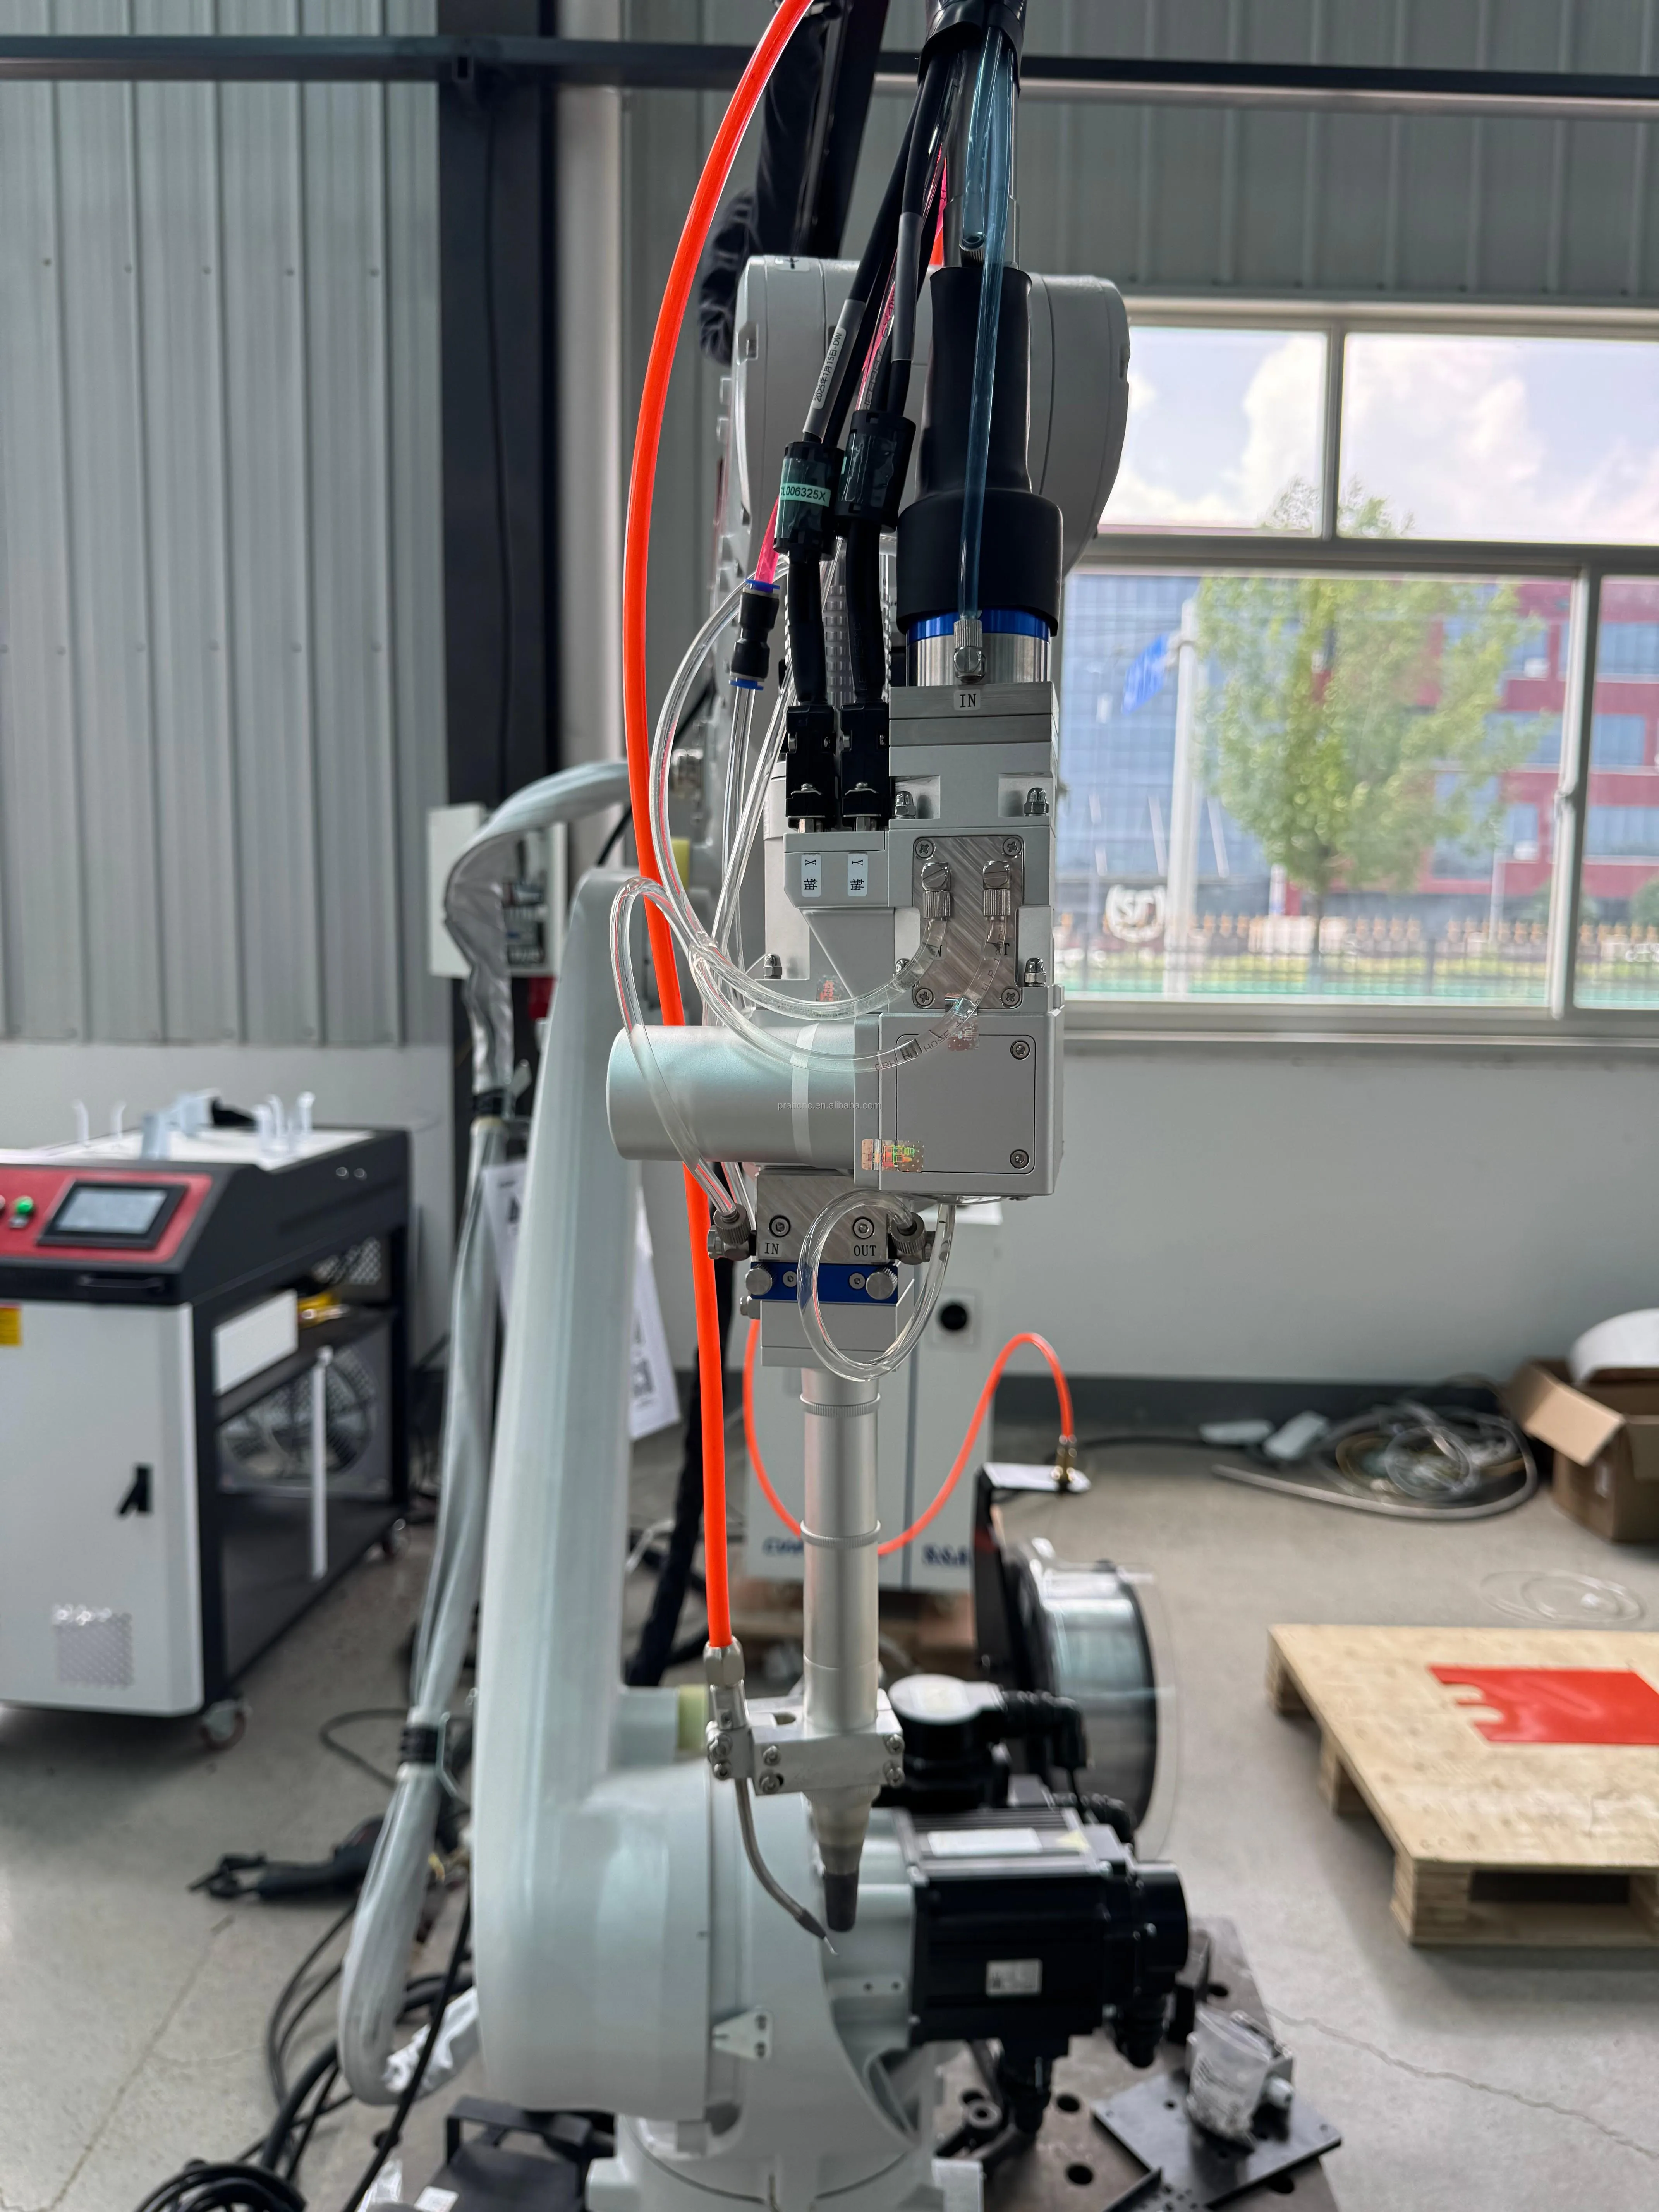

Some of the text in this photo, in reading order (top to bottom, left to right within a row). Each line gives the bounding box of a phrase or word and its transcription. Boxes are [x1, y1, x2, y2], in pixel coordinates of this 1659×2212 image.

[960, 693, 977, 708] IN
[764, 1242, 780, 1255] IN
[854, 1245, 877, 1256] OUT
